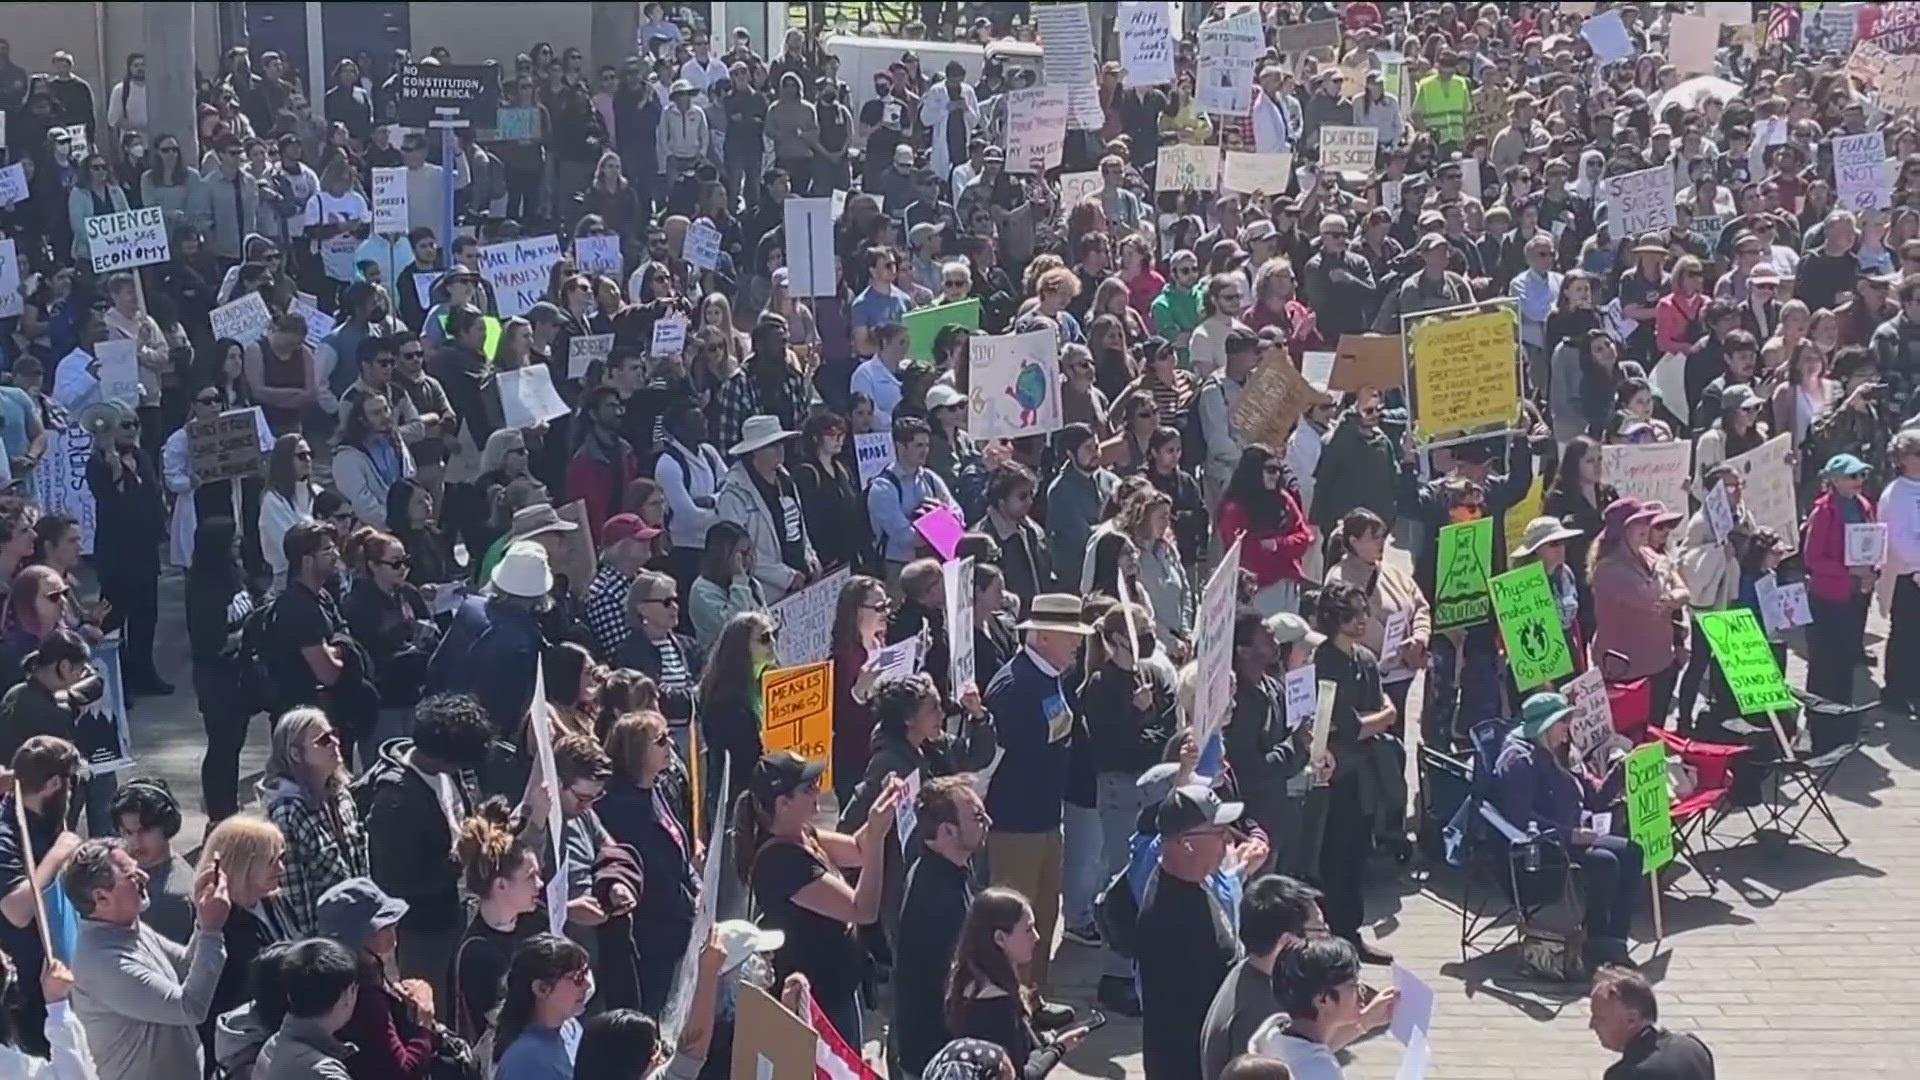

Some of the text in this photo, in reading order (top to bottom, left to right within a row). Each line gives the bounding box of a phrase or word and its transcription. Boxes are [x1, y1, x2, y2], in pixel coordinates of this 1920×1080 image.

[402, 65, 418, 76] NO
[402, 76, 484, 94] CONSTITUTION,
[402, 87, 418, 98] NO
[1839, 135, 1880, 153] FUND
[1843, 163, 1876, 182] NOT
[88, 208, 161, 240] SCIENCE
[1622, 208, 1670, 235] LIVES
[93, 244, 167, 271] ECONOMY
[858, 444, 888, 463] MADE
[1492, 573, 1546, 603] Physics
[1436, 598, 1489, 626] SOLUTION
[1499, 605, 1533, 624] makes
[1728, 614, 1757, 635] WATT
[771, 675, 821, 704] MEASLES
[1733, 673, 1766, 689] STAND
[769, 700, 806, 721] TESTING
[1638, 786, 1660, 818] NOT
